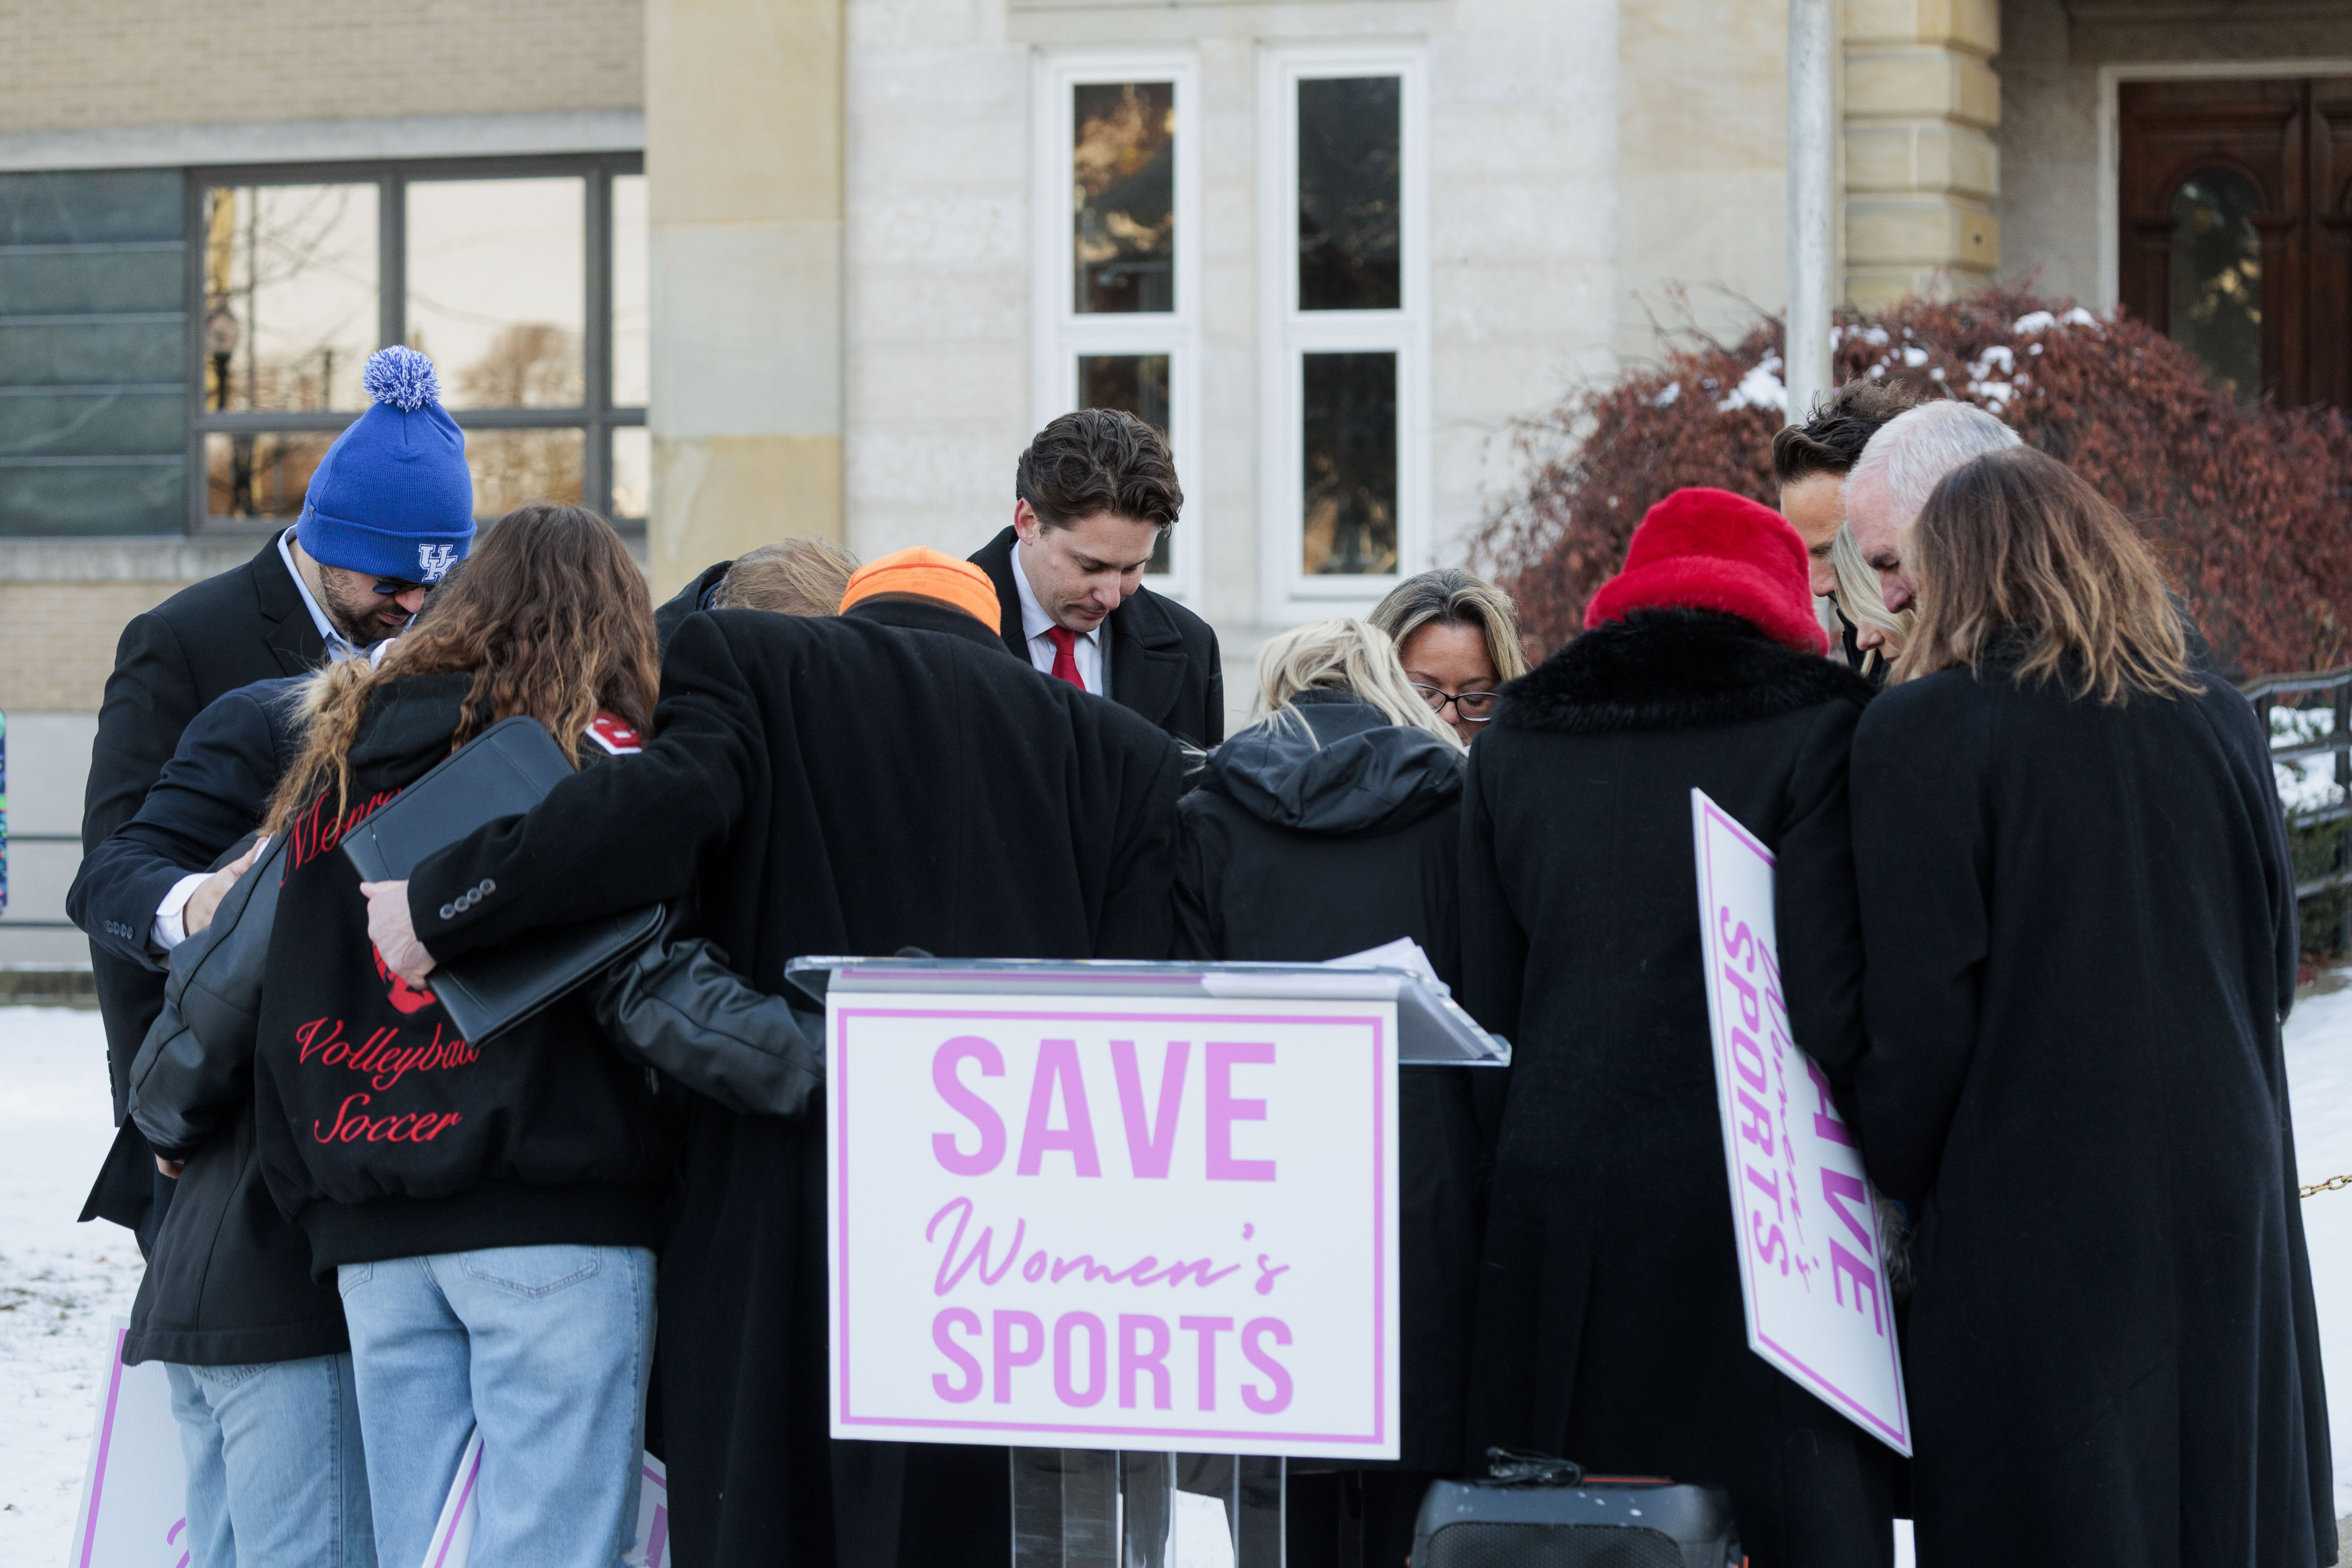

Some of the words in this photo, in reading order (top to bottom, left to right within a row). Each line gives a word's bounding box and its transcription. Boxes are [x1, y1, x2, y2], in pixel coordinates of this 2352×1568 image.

[314, 1092, 463, 1144] Soccer
[931, 1036, 1277, 1182] SAVE
[1720, 905, 1790, 1277] SPORTS
[925, 1196, 1290, 1297] Women's
[1806, 1055, 1884, 1338] AVE
[931, 1307, 1294, 1415] SPORTS
